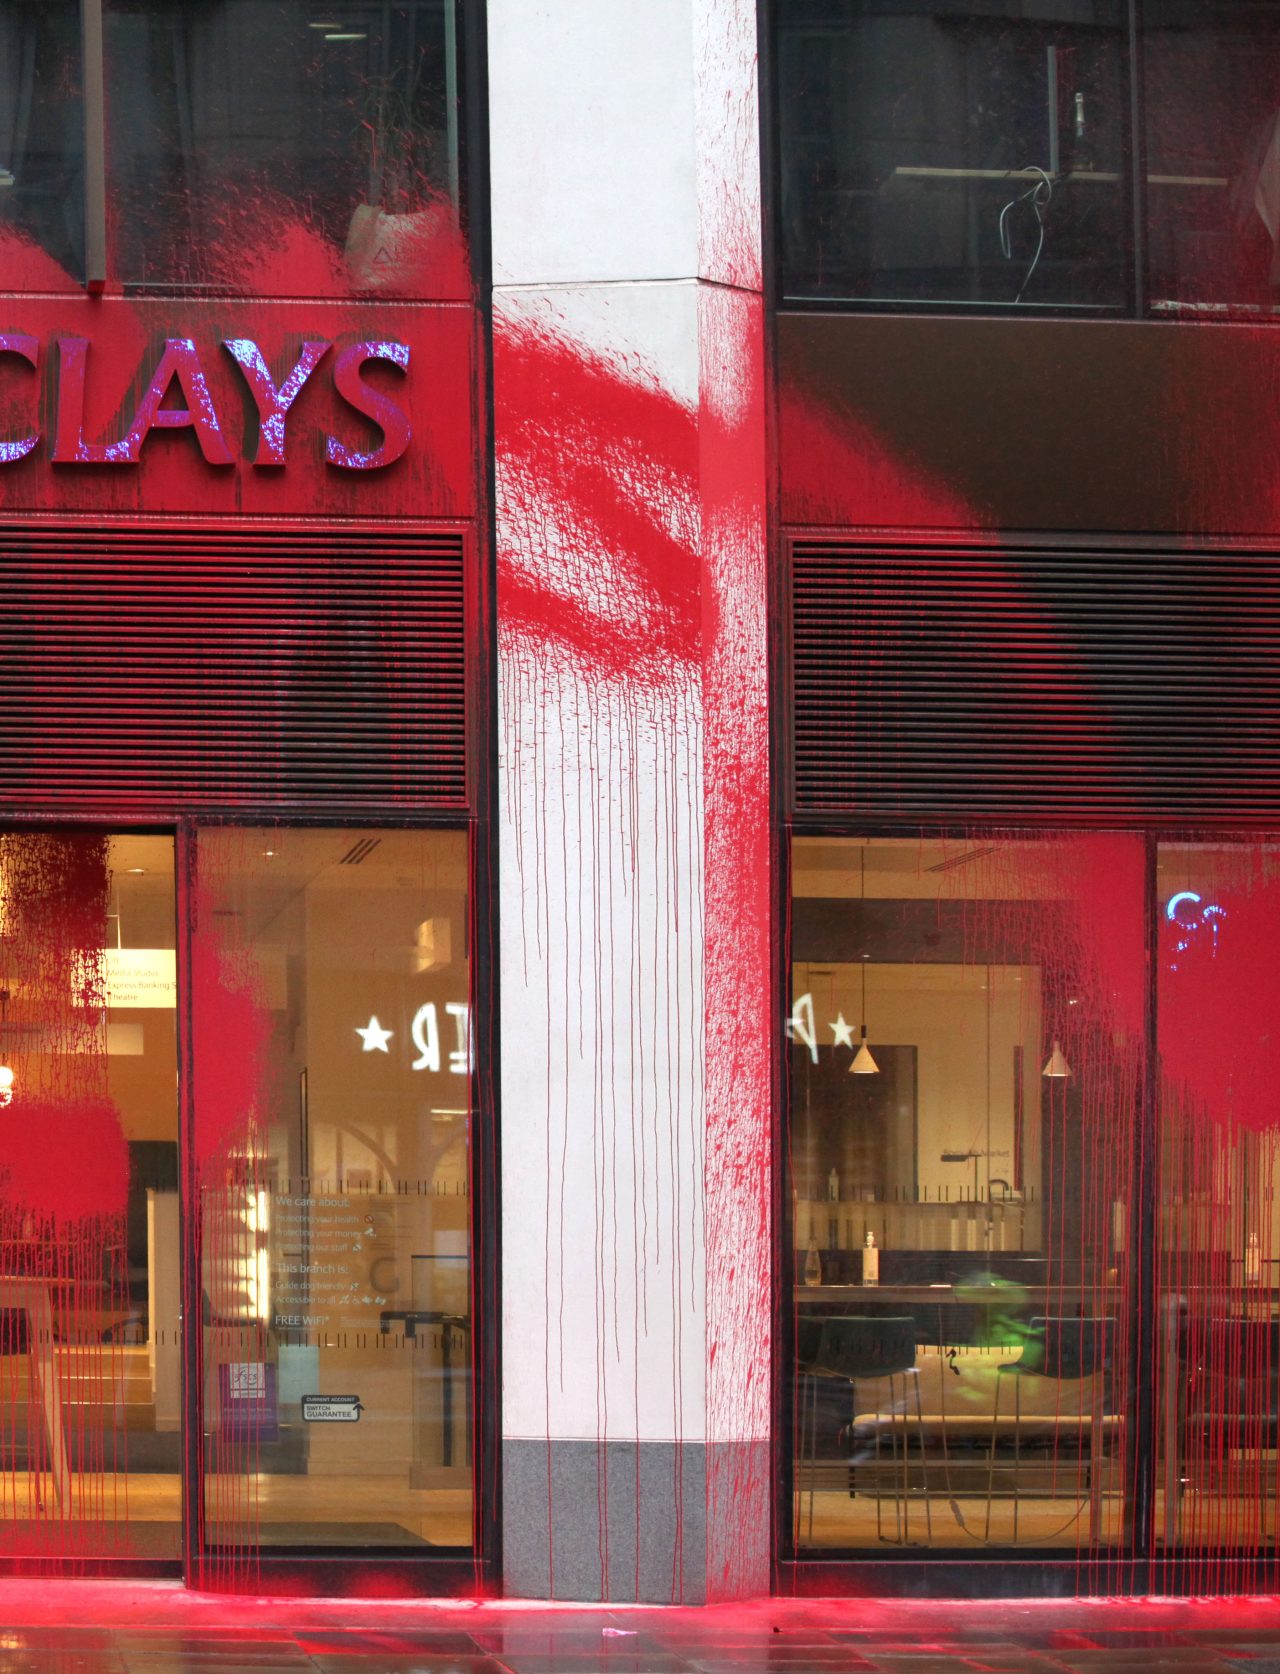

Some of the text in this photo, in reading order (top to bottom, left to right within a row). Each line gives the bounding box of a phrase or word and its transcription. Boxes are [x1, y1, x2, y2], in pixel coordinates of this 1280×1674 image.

[107, 981, 137, 991] Express
[138, 980, 170, 991] Banking
[276, 1196, 293, 1207] We
[294, 1198, 316, 1207] care
[335, 1214, 359, 1223] health
[335, 1230, 362, 1240] money
[277, 1262, 298, 1273] This
[300, 1262, 335, 1273] branch
[275, 1280, 299, 1290] Guide
[300, 1280, 314, 1291] dog
[275, 1295, 336, 1304] Accessible to all
[275, 1315, 301, 1326] FREE
